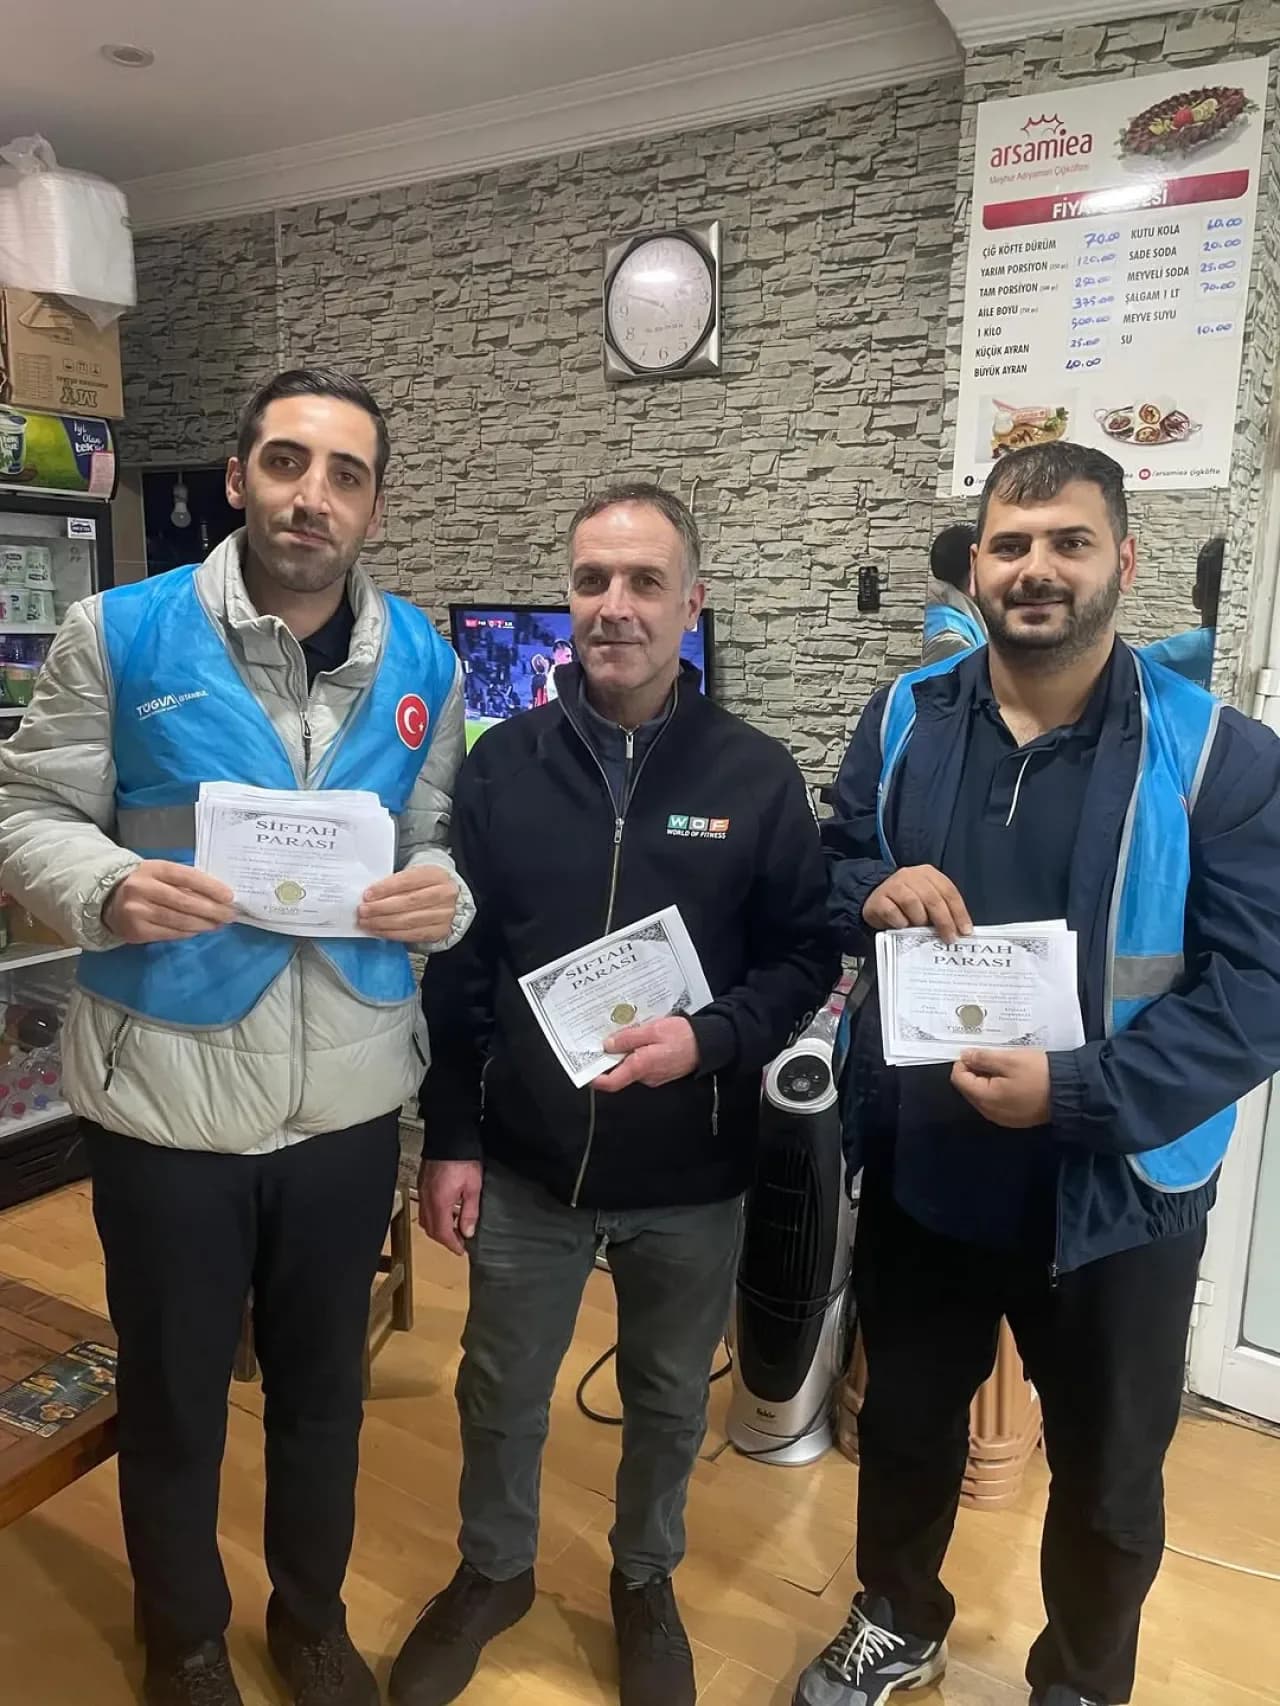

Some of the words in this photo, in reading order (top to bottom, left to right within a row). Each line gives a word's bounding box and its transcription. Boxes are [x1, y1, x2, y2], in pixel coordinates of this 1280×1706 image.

[990, 128, 1092, 168] arsamiea
[1131, 227, 1155, 240] KUTU
[1157, 224, 1180, 236] KOLA
[998, 242, 1023, 255] KÖFTE
[1025, 239, 1057, 252] DÜRÜM
[1203, 238, 1241, 251] 20.00
[1129, 249, 1151, 260] SADE
[1153, 246, 1177, 258] SODA
[981, 265, 1006, 277] YARIM
[1007, 261, 1048, 275] PORSİYON
[1200, 260, 1236, 272] 25.00
[1127, 267, 1163, 282] MEYVELİ
[1165, 266, 1189, 278] SODA
[980, 287, 996, 297] TAM
[998, 283, 1038, 295] PORSİYON
[1200, 281, 1236, 293] 70.00
[1125, 290, 1160, 304] ŞALGAM
[1171, 288, 1180, 298] LT
[978, 305, 994, 317] AİLE
[996, 305, 1019, 316] BOYU
[1123, 312, 1151, 323] MEYVE
[1153, 309, 1177, 321] SUYU
[977, 328, 981, 337] 1
[984, 325, 1002, 337] KİLO
[1197, 323, 1233, 335] 10.00
[1121, 334, 1133, 344] SU
[658, 346, 669, 361] 6
[975, 344, 1001, 358] KÜÇÜK
[1004, 344, 1030, 354] AYRAN
[974, 364, 1000, 377] BÜYÜK
[1002, 364, 1028, 375] AYRAN
[666, 829, 690, 837] WORLD
[256, 834, 336, 849] PARASI
[934, 956, 1012, 968] PARASI
[571, 954, 639, 990] PARASI
